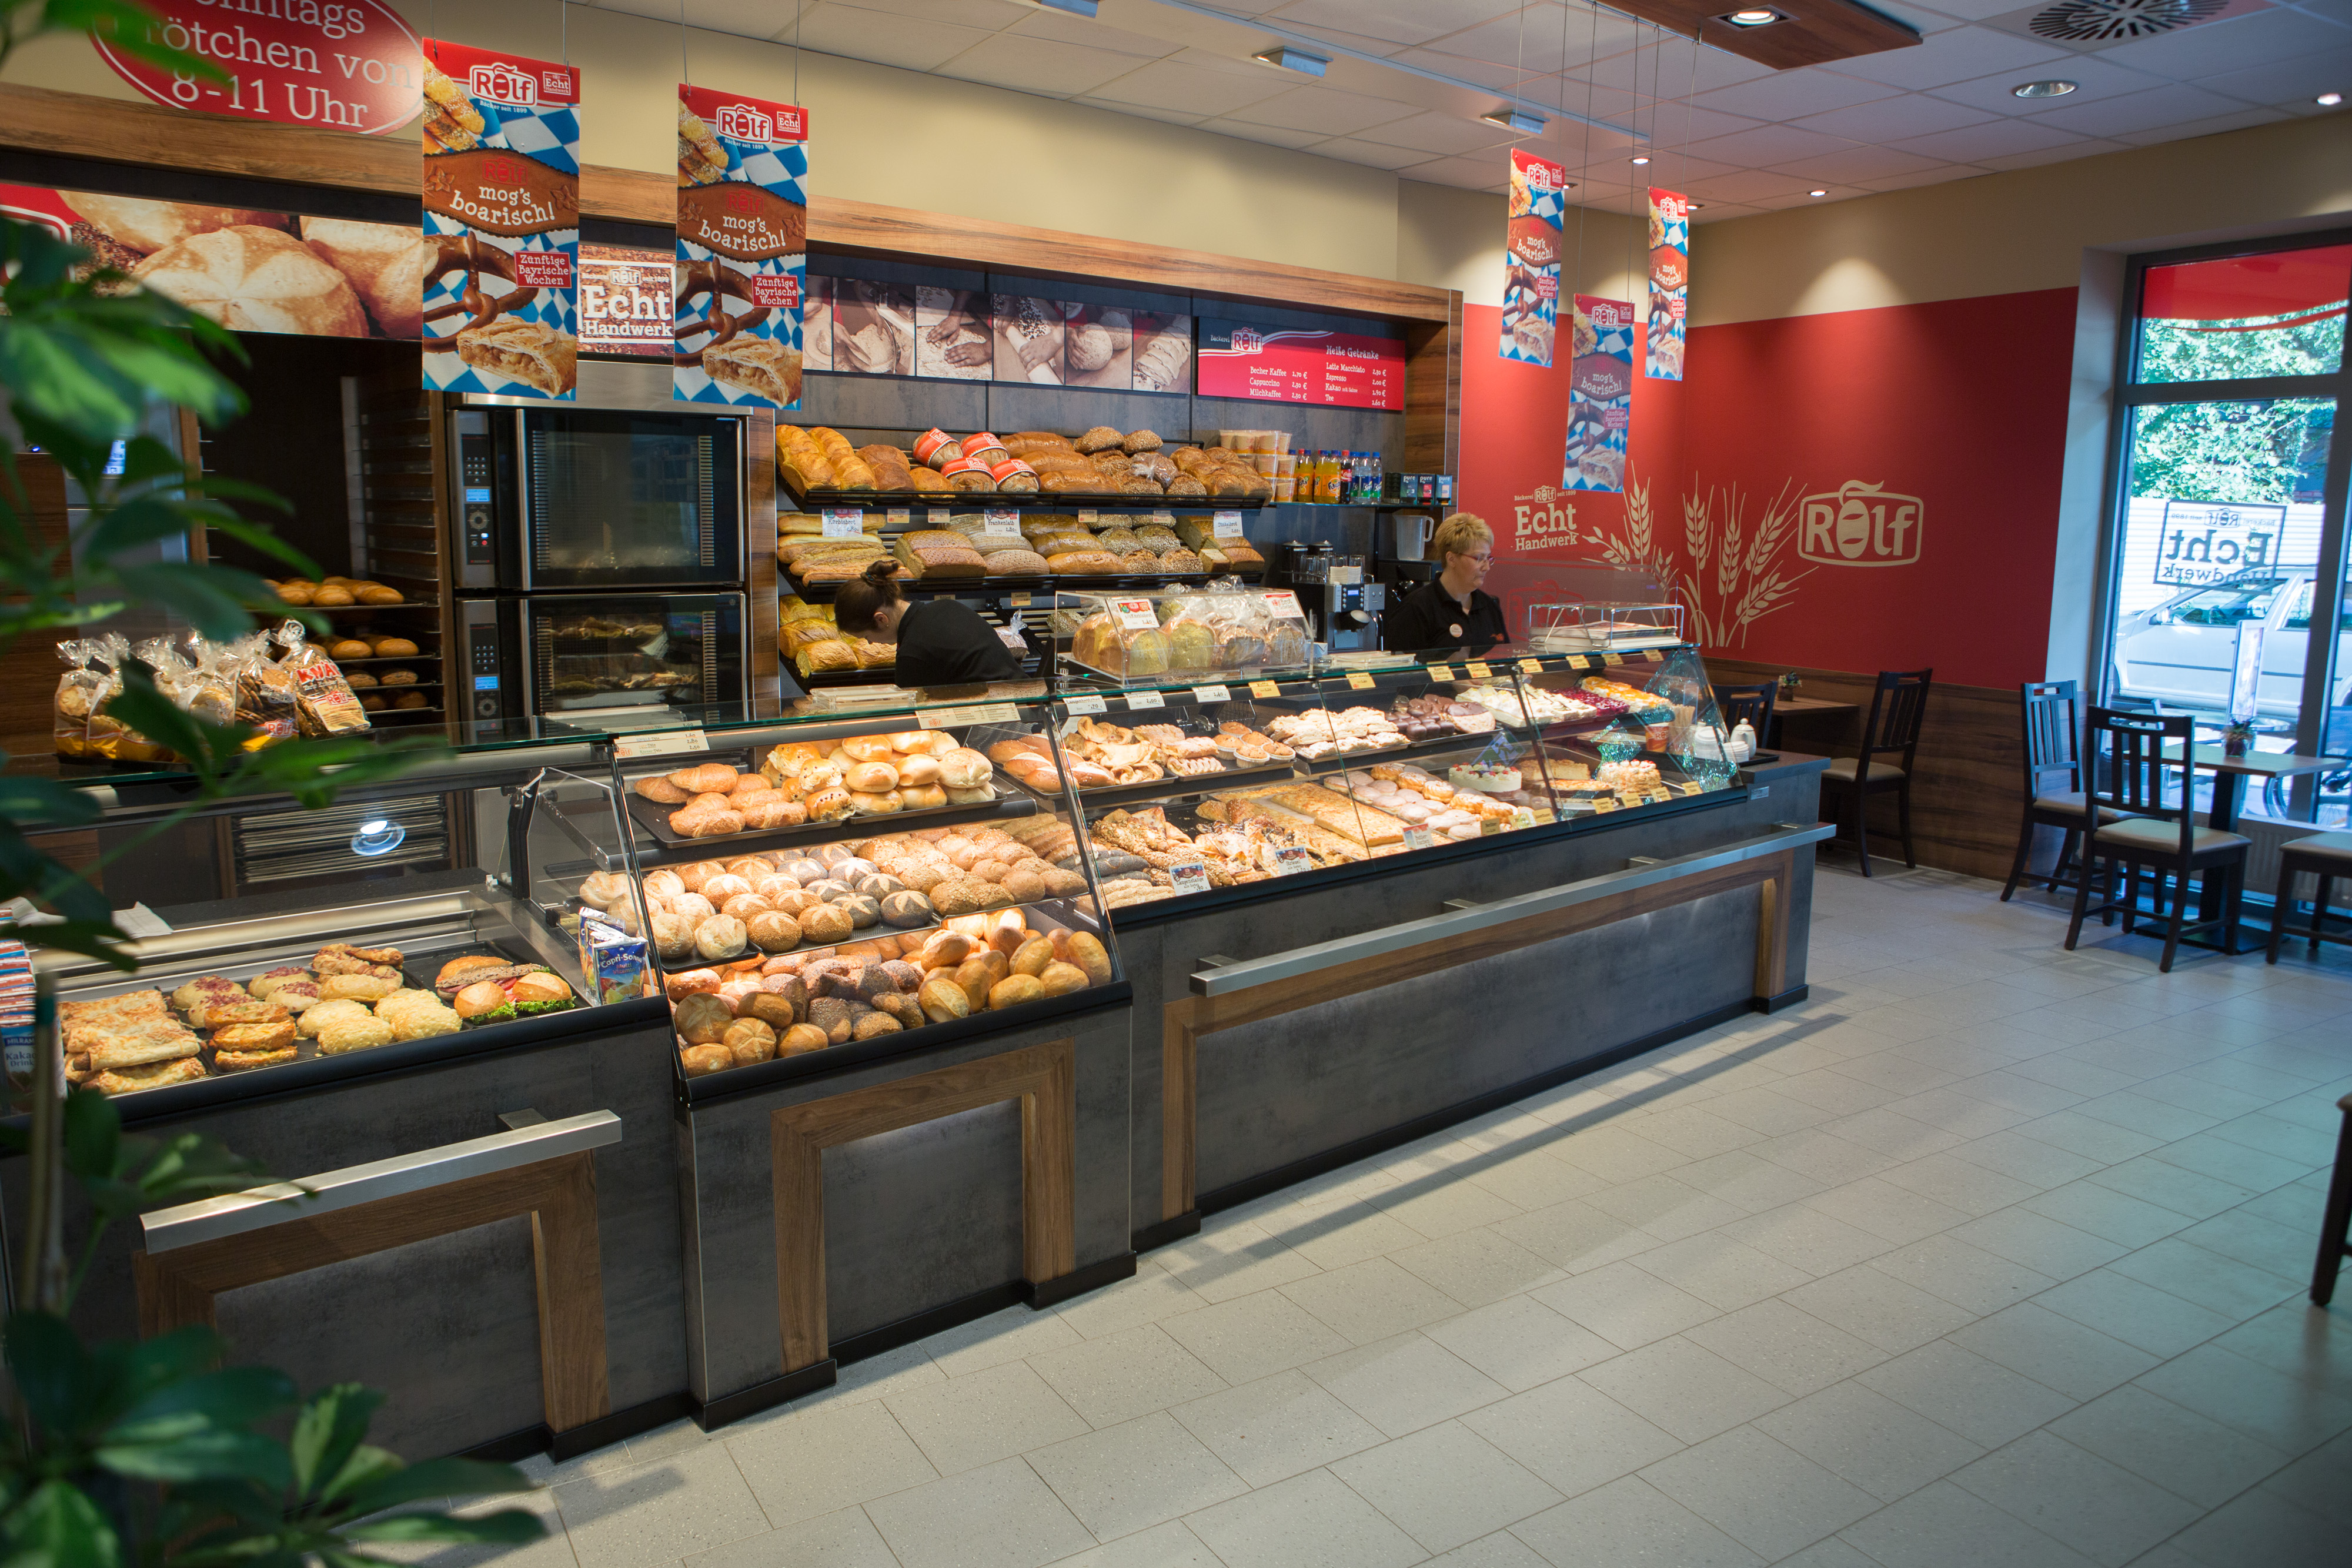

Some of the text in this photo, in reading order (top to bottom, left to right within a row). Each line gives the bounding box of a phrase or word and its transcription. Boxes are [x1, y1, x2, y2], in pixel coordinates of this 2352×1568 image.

[146, 16, 415, 89] rötchen von
[476, 70, 532, 102] Rolf
[545, 78, 569, 89] Echt
[284, 83, 368, 128] Uhr
[480, 100, 500, 111] Bäcker
[721, 112, 767, 139] Rolf
[779, 117, 799, 128] Echt
[724, 138, 741, 147] Bäcker
[485, 162, 525, 183] Rolf
[1529, 169, 1548, 186] Rolf
[449, 189, 555, 226] boarisch!
[698, 219, 786, 252] boarisch!
[1516, 239, 1553, 260] boarisch!
[520, 254, 565, 268] Zünftige
[518, 265, 569, 277] Bayrische
[612, 270, 639, 284] Rolf
[1655, 268, 1682, 286] boarisch!
[524, 274, 564, 285] Wochen
[756, 278, 794, 289] Zünftige
[754, 286, 797, 297] Bayrische
[582, 285, 672, 320] Echt
[760, 295, 793, 305] Wochen
[1594, 309, 1616, 325] Rolf
[584, 320, 673, 337] Handwerk
[1210, 333, 1260, 350] Bäckerei Rolf
[1326, 345, 1379, 360] Heiße Getränke
[1250, 366, 1268, 375] Becher
[1269, 367, 1287, 377] Kaffee
[1326, 362, 1339, 370] Latte
[1341, 363, 1365, 373] Macchiato
[1250, 377, 1280, 387] Cappuccino
[1326, 373, 1347, 382] Espresso
[1325, 383, 1341, 392] Kakao
[1581, 377, 1622, 395] boarisch!
[1250, 388, 1281, 398] Milchkaffee
[1302, 393, 1307, 401] €
[1536, 489, 1555, 501] Rolf
[1514, 503, 1577, 536] Echt
[1805, 499, 1916, 559] Rolf
[1515, 531, 1578, 551] Handwerk
[327, 694, 346, 704] Rolf
[268, 723, 292, 735] Rolf
[1177, 877, 1204, 885] Laugenstange
[601, 952, 643, 968] Capri-Sonne
